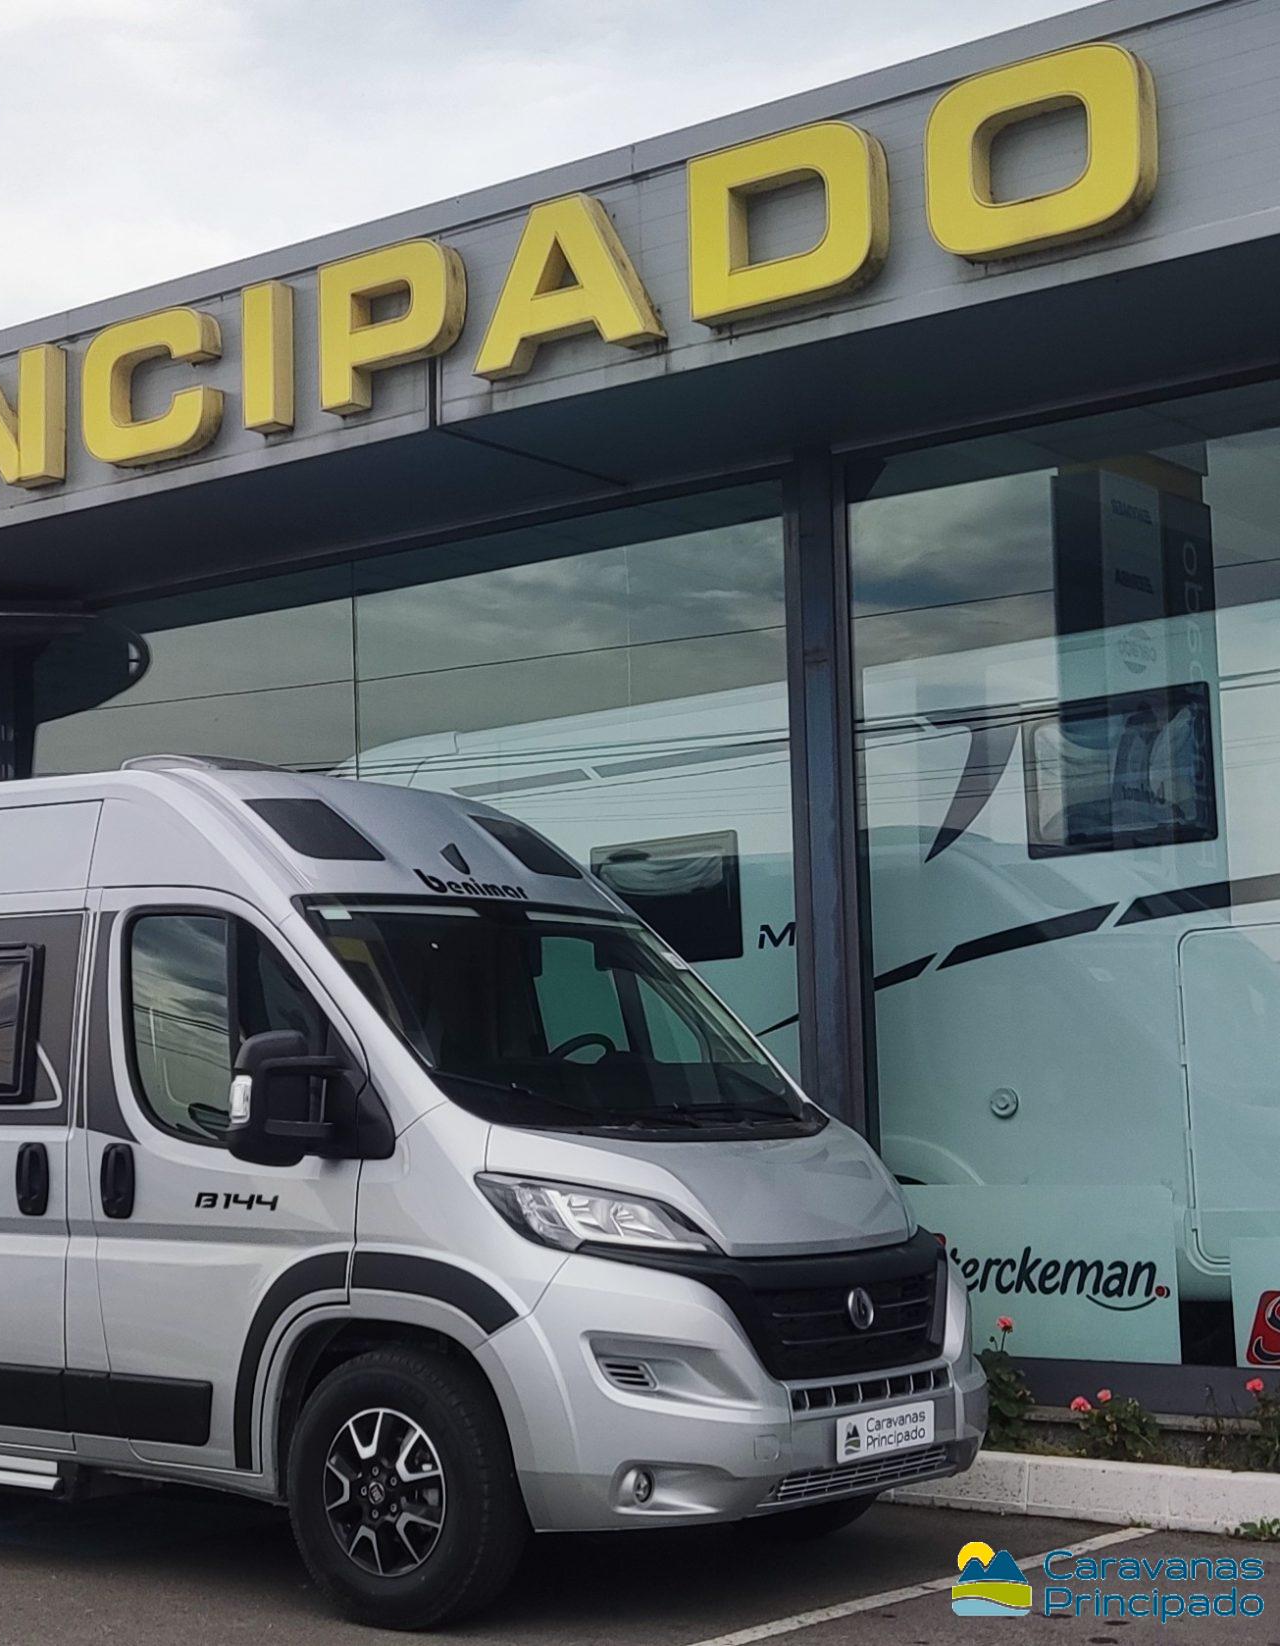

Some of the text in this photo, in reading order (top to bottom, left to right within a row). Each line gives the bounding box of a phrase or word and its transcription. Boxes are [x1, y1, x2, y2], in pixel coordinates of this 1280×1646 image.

[412, 868, 529, 900] benimar
[194, 1191, 280, 1212] B144
[866, 1410, 926, 1433] Caravanas
[866, 1425, 926, 1451] Principado
